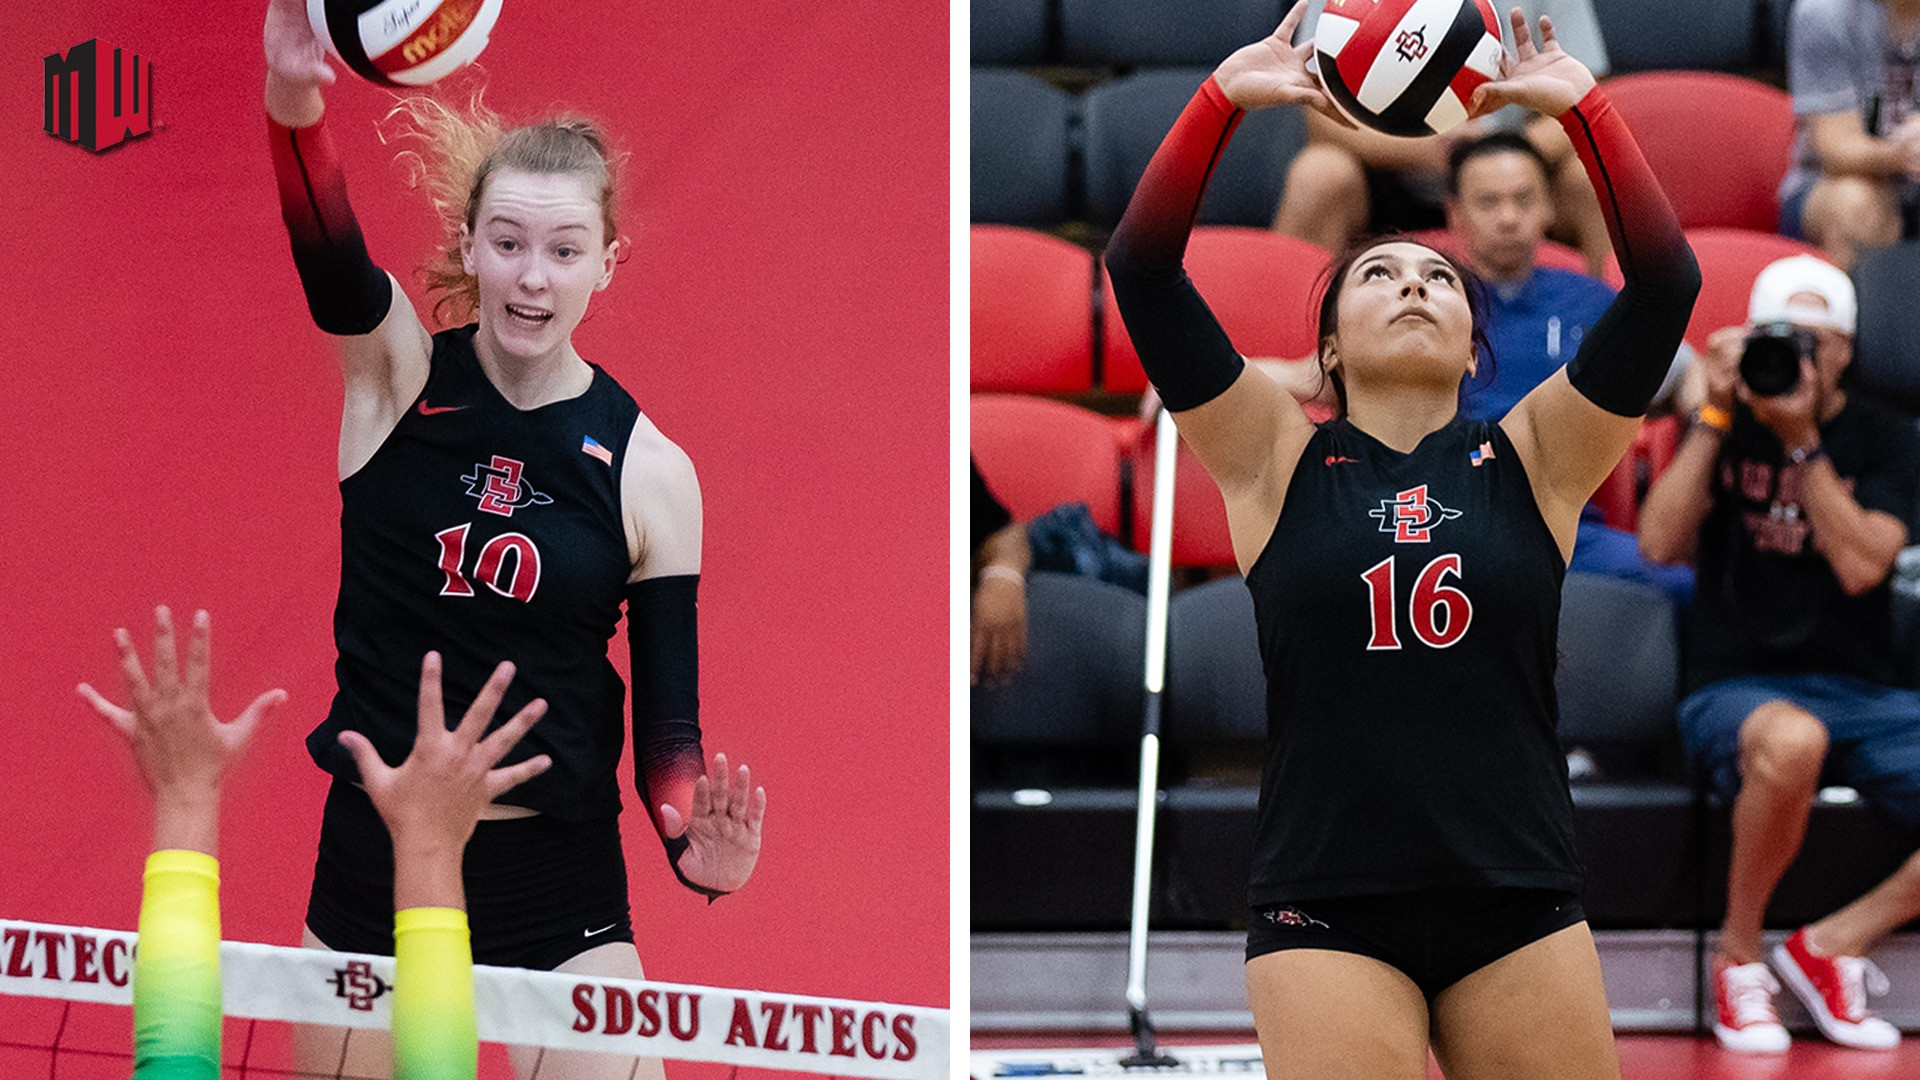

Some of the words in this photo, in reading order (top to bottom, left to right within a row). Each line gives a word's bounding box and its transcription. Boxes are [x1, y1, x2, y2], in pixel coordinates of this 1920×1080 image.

[435, 522, 541, 603] 10
[1360, 554, 1473, 650] 16
[0, 928, 137, 987] ZTEC
[571, 984, 701, 1042] SDSU
[724, 997, 918, 1062] AZTECS
